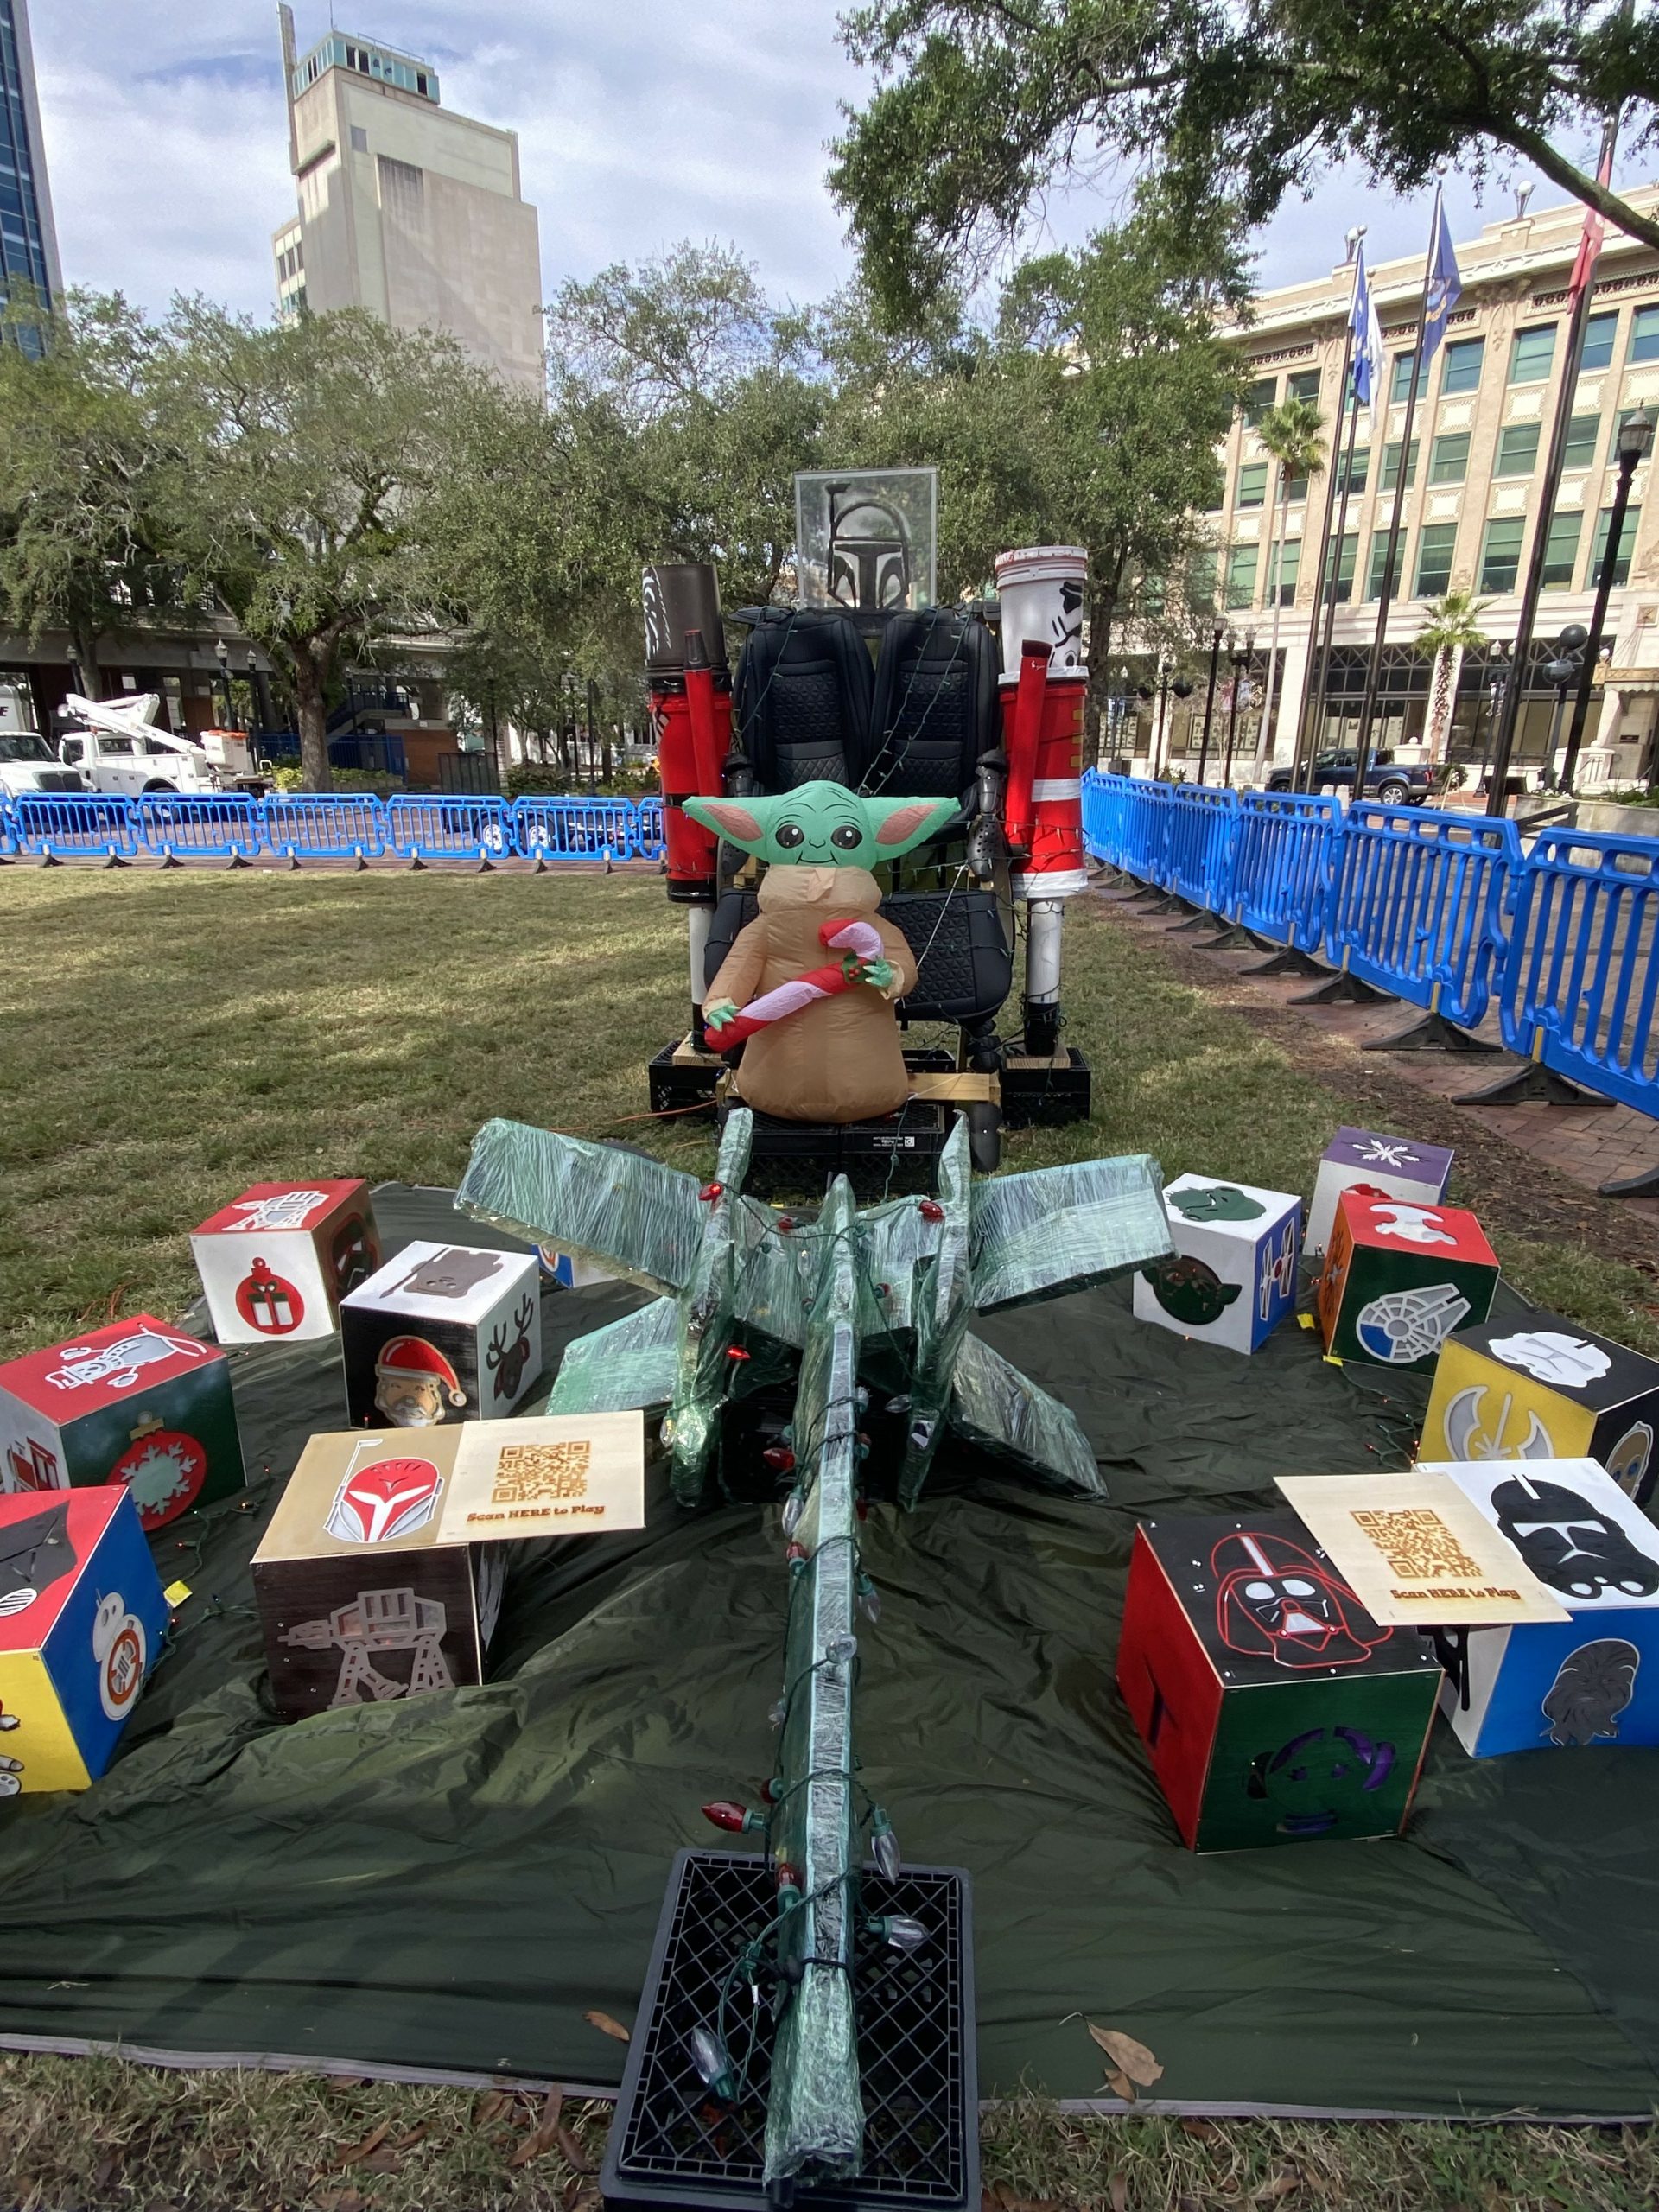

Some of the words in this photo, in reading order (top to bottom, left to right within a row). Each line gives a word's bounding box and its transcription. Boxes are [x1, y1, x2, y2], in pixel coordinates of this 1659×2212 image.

[467, 1512, 505, 1522] Scan
[508, 1508, 551, 1519] HERE
[554, 1507, 569, 1516] to
[571, 1504, 605, 1515] Play
[1390, 1589, 1429, 1599] Scan
[1427, 1588, 1471, 1599] HERE
[1469, 1588, 1485, 1598] to
[1484, 1586, 1522, 1600] Play
